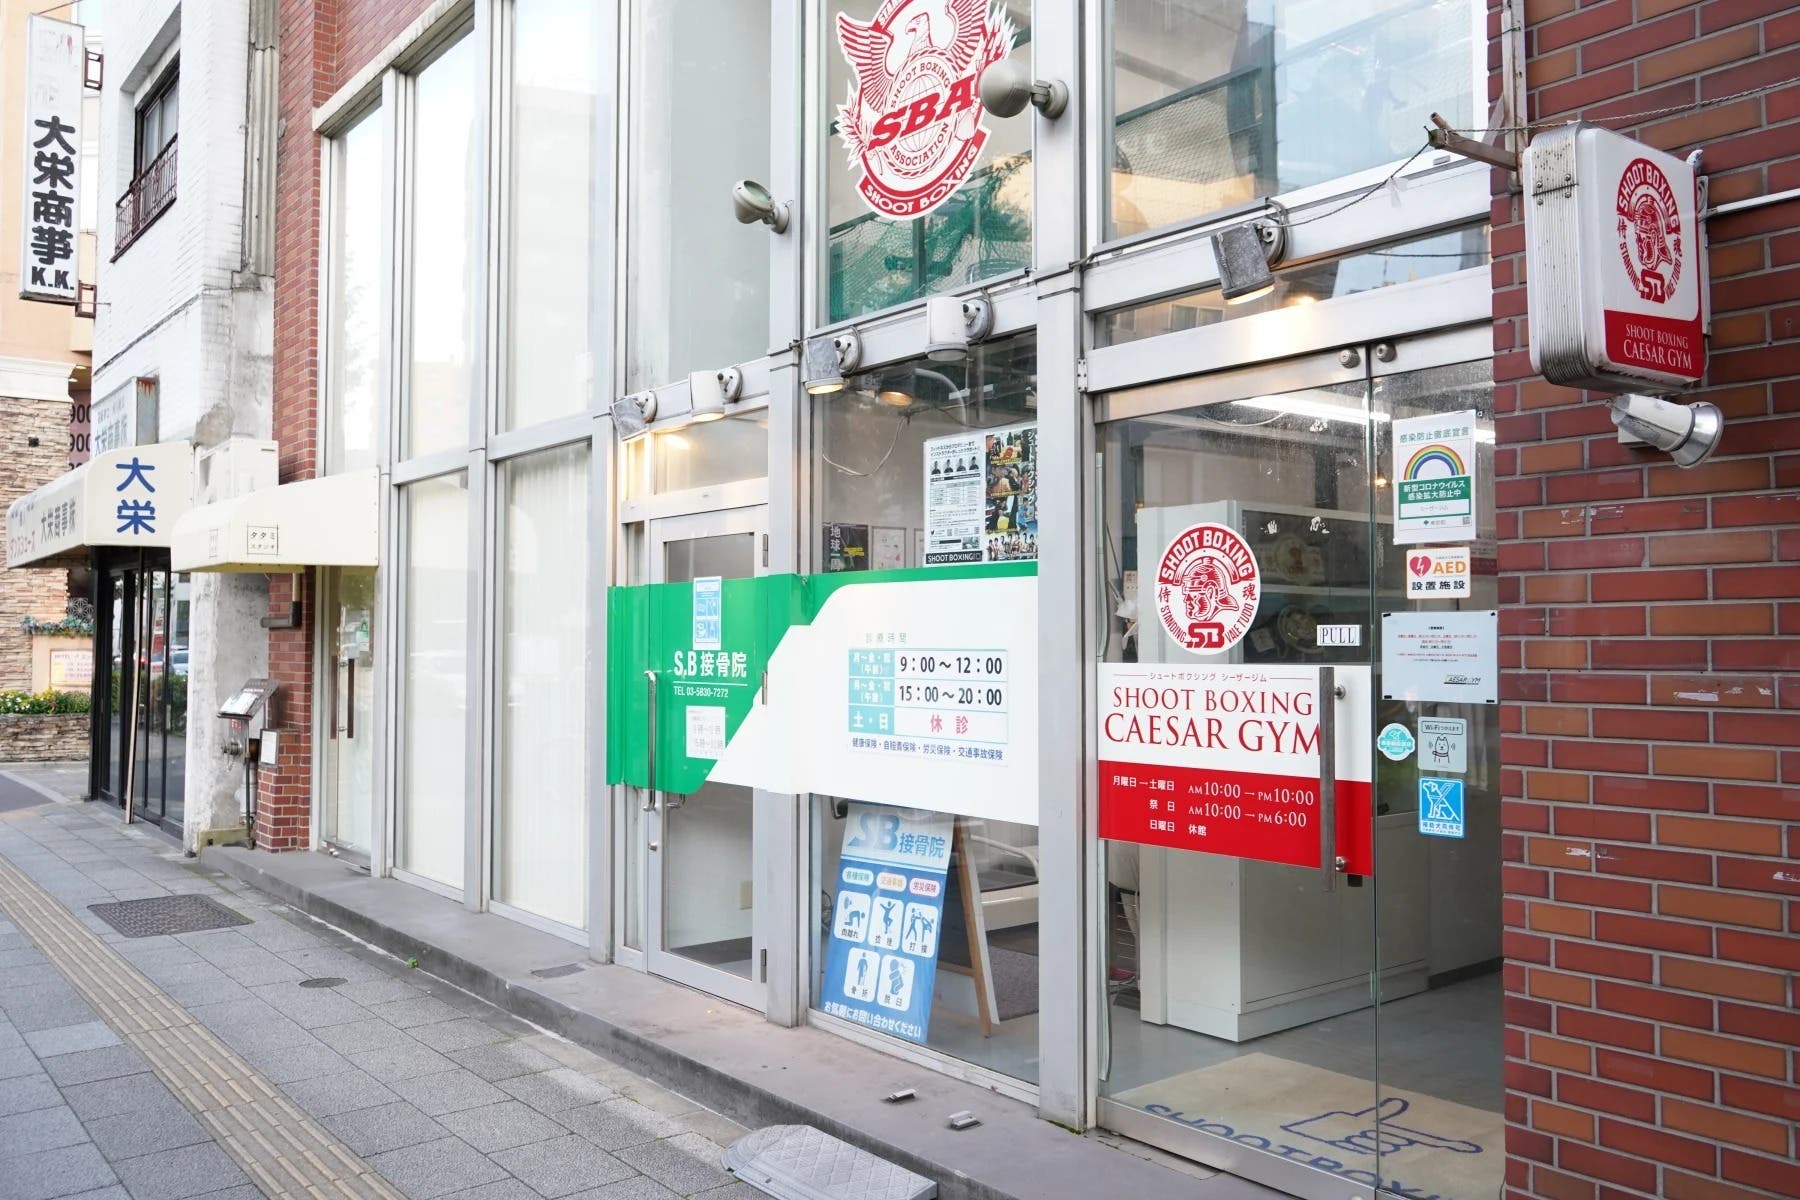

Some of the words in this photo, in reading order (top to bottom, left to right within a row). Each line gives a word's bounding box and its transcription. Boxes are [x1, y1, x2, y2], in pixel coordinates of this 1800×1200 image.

[891, 67, 917, 108] SHOOT
[919, 62, 951, 89] BOXING
[867, 73, 977, 151] SBA
[890, 123, 949, 167] ASSOCIATION
[864, 184, 915, 213] SHOOT
[919, 144, 976, 208] BOXING
[1618, 163, 1645, 211] SHOOT
[1646, 164, 1680, 226] BOXING
[31, 266, 75, 291] K.K.
[1625, 323, 1655, 342] SHOOT
[1657, 330, 1689, 350] BOXING
[1623, 340, 1666, 365] CAESAR
[1667, 351, 1692, 370] GYM
[116, 457, 156, 535] 大栄
[1403, 480, 1466, 493] 新型コロナウイルス
[1408, 489, 1461, 501] 感染拡大防止中
[1161, 530, 1201, 580] SHOOT
[1203, 529, 1254, 577] BOXING
[1433, 560, 1467, 575] AED
[1158, 586, 1172, 603] 侍
[1241, 583, 1257, 601] 魂
[1411, 581, 1466, 591] 設置施設
[1161, 604, 1187, 643] STANDING
[1224, 624, 1243, 643] VALE
[1239, 602, 1255, 628] TUDO
[1321, 626, 1355, 644] PULL
[1150, 672, 1216, 681] シュートボクシング
[1221, 673, 1267, 682] シーザージム
[674, 686, 685, 696] TEL
[686, 686, 729, 698] 03-5830-7272
[1112, 686, 1195, 711] SHOOT
[1205, 689, 1313, 716] BOXING
[930, 714, 969, 735] 休診
[1104, 712, 1230, 750] CAESAR
[1238, 719, 1322, 756] GYM
[1149, 819, 1175, 833] 日曜日
[1188, 824, 1207, 837] 休館
